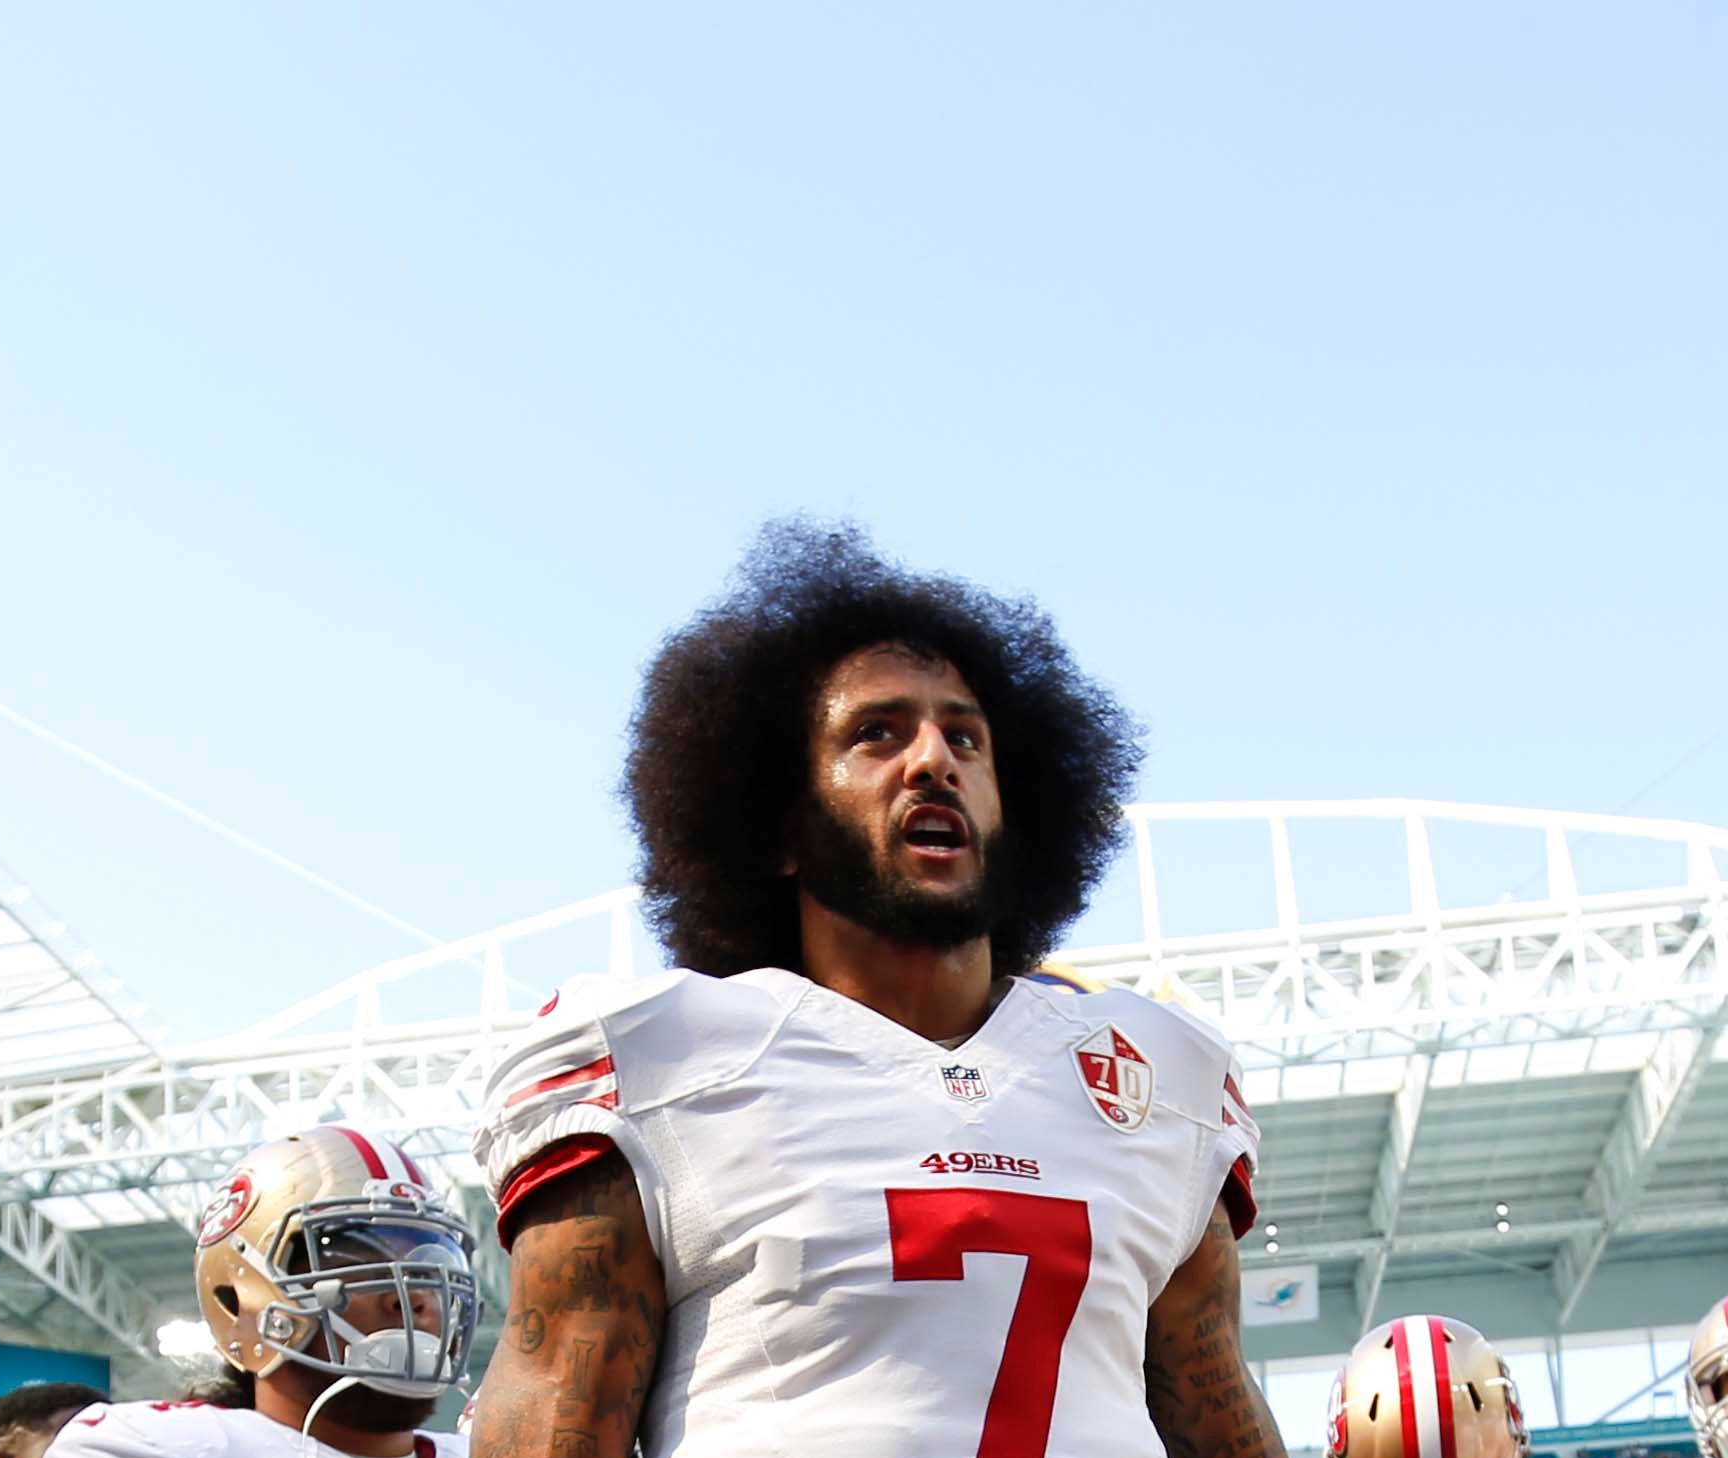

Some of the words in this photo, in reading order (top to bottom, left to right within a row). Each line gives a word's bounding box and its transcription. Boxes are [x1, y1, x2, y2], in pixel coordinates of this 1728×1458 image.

[945, 1077, 985, 1098] NFL
[1089, 1055, 1144, 1101] 70
[919, 1151, 1041, 1181] 49ERS
